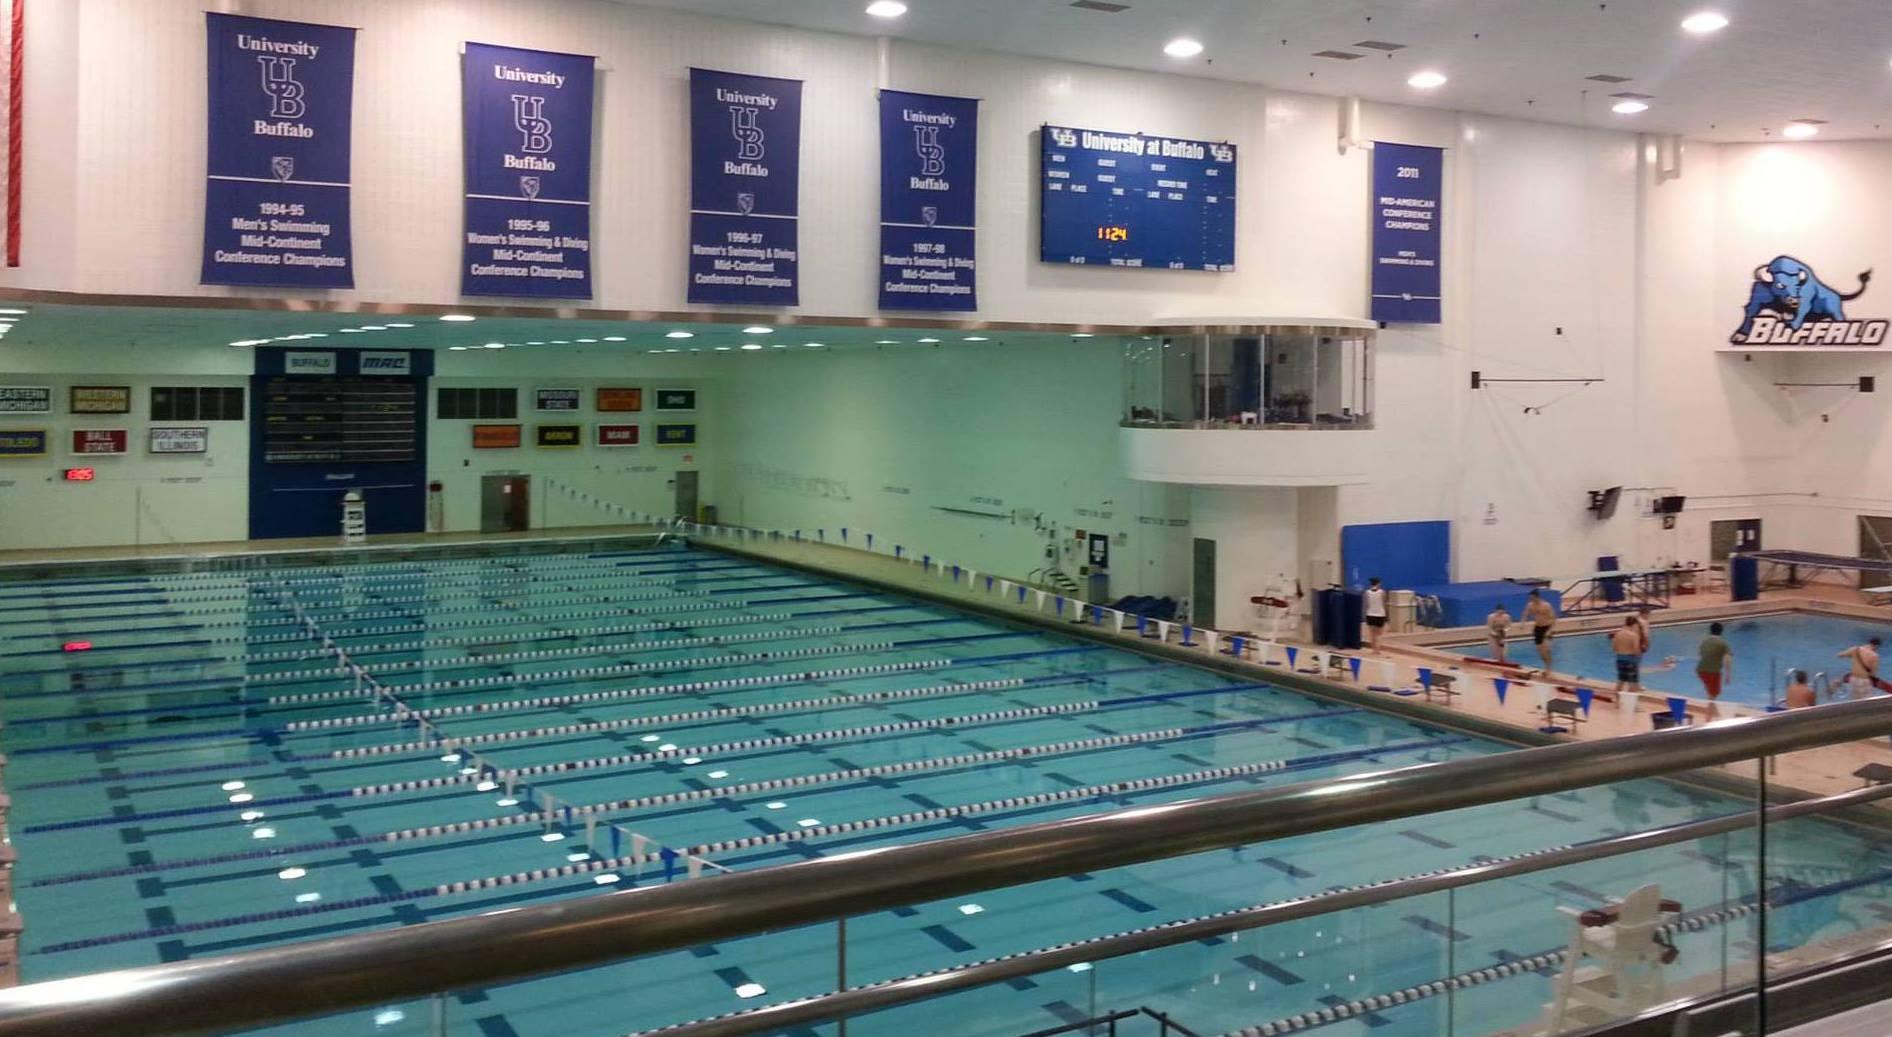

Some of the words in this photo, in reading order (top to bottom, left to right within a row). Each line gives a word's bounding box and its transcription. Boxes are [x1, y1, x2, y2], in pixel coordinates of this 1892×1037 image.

[237, 34, 319, 58] University
[494, 65, 565, 88] University
[716, 88, 778, 109] University
[903, 109, 956, 128] University
[254, 120, 314, 138] Buffalo
[1082, 132, 1145, 156] University
[1146, 140, 1161, 155] at
[1162, 140, 1205, 160] Buffalo
[504, 154, 556, 171] Buffalo
[724, 161, 768, 177] Buffalo
[1396, 167, 1419, 179] 2011
[910, 177, 949, 191] Buffalo
[260, 202, 305, 216] 1994-95
[1380, 196, 1435, 208] MID-AMERICAN
[1382, 208, 1433, 219] CONFERENCE
[232, 217, 268, 231] Men's
[270, 219, 331, 236] Swimming
[508, 219, 550, 232] 1995-96
[1385, 220, 1430, 231] CHAMPIONS
[241, 235, 322, 249] Mid-Continent
[468, 232, 508, 245] Women's
[508, 234, 553, 249] Swimming
[554, 236, 561, 248] &
[562, 237, 589, 251] Diving
[215, 250, 281, 264] Conference
[283, 252, 346, 268] Champions
[493, 249, 563, 263] Mid-Continent
[471, 264, 529, 276] Conference
[530, 266, 585, 280] Champions
[714, 260, 774, 272] Mid-Continent
[695, 273, 744, 285] Conference
[745, 275, 792, 288] Champions
[886, 282, 928, 293] Conference
[929, 283, 971, 295] Champions
[362, 357, 409, 368] MAC
